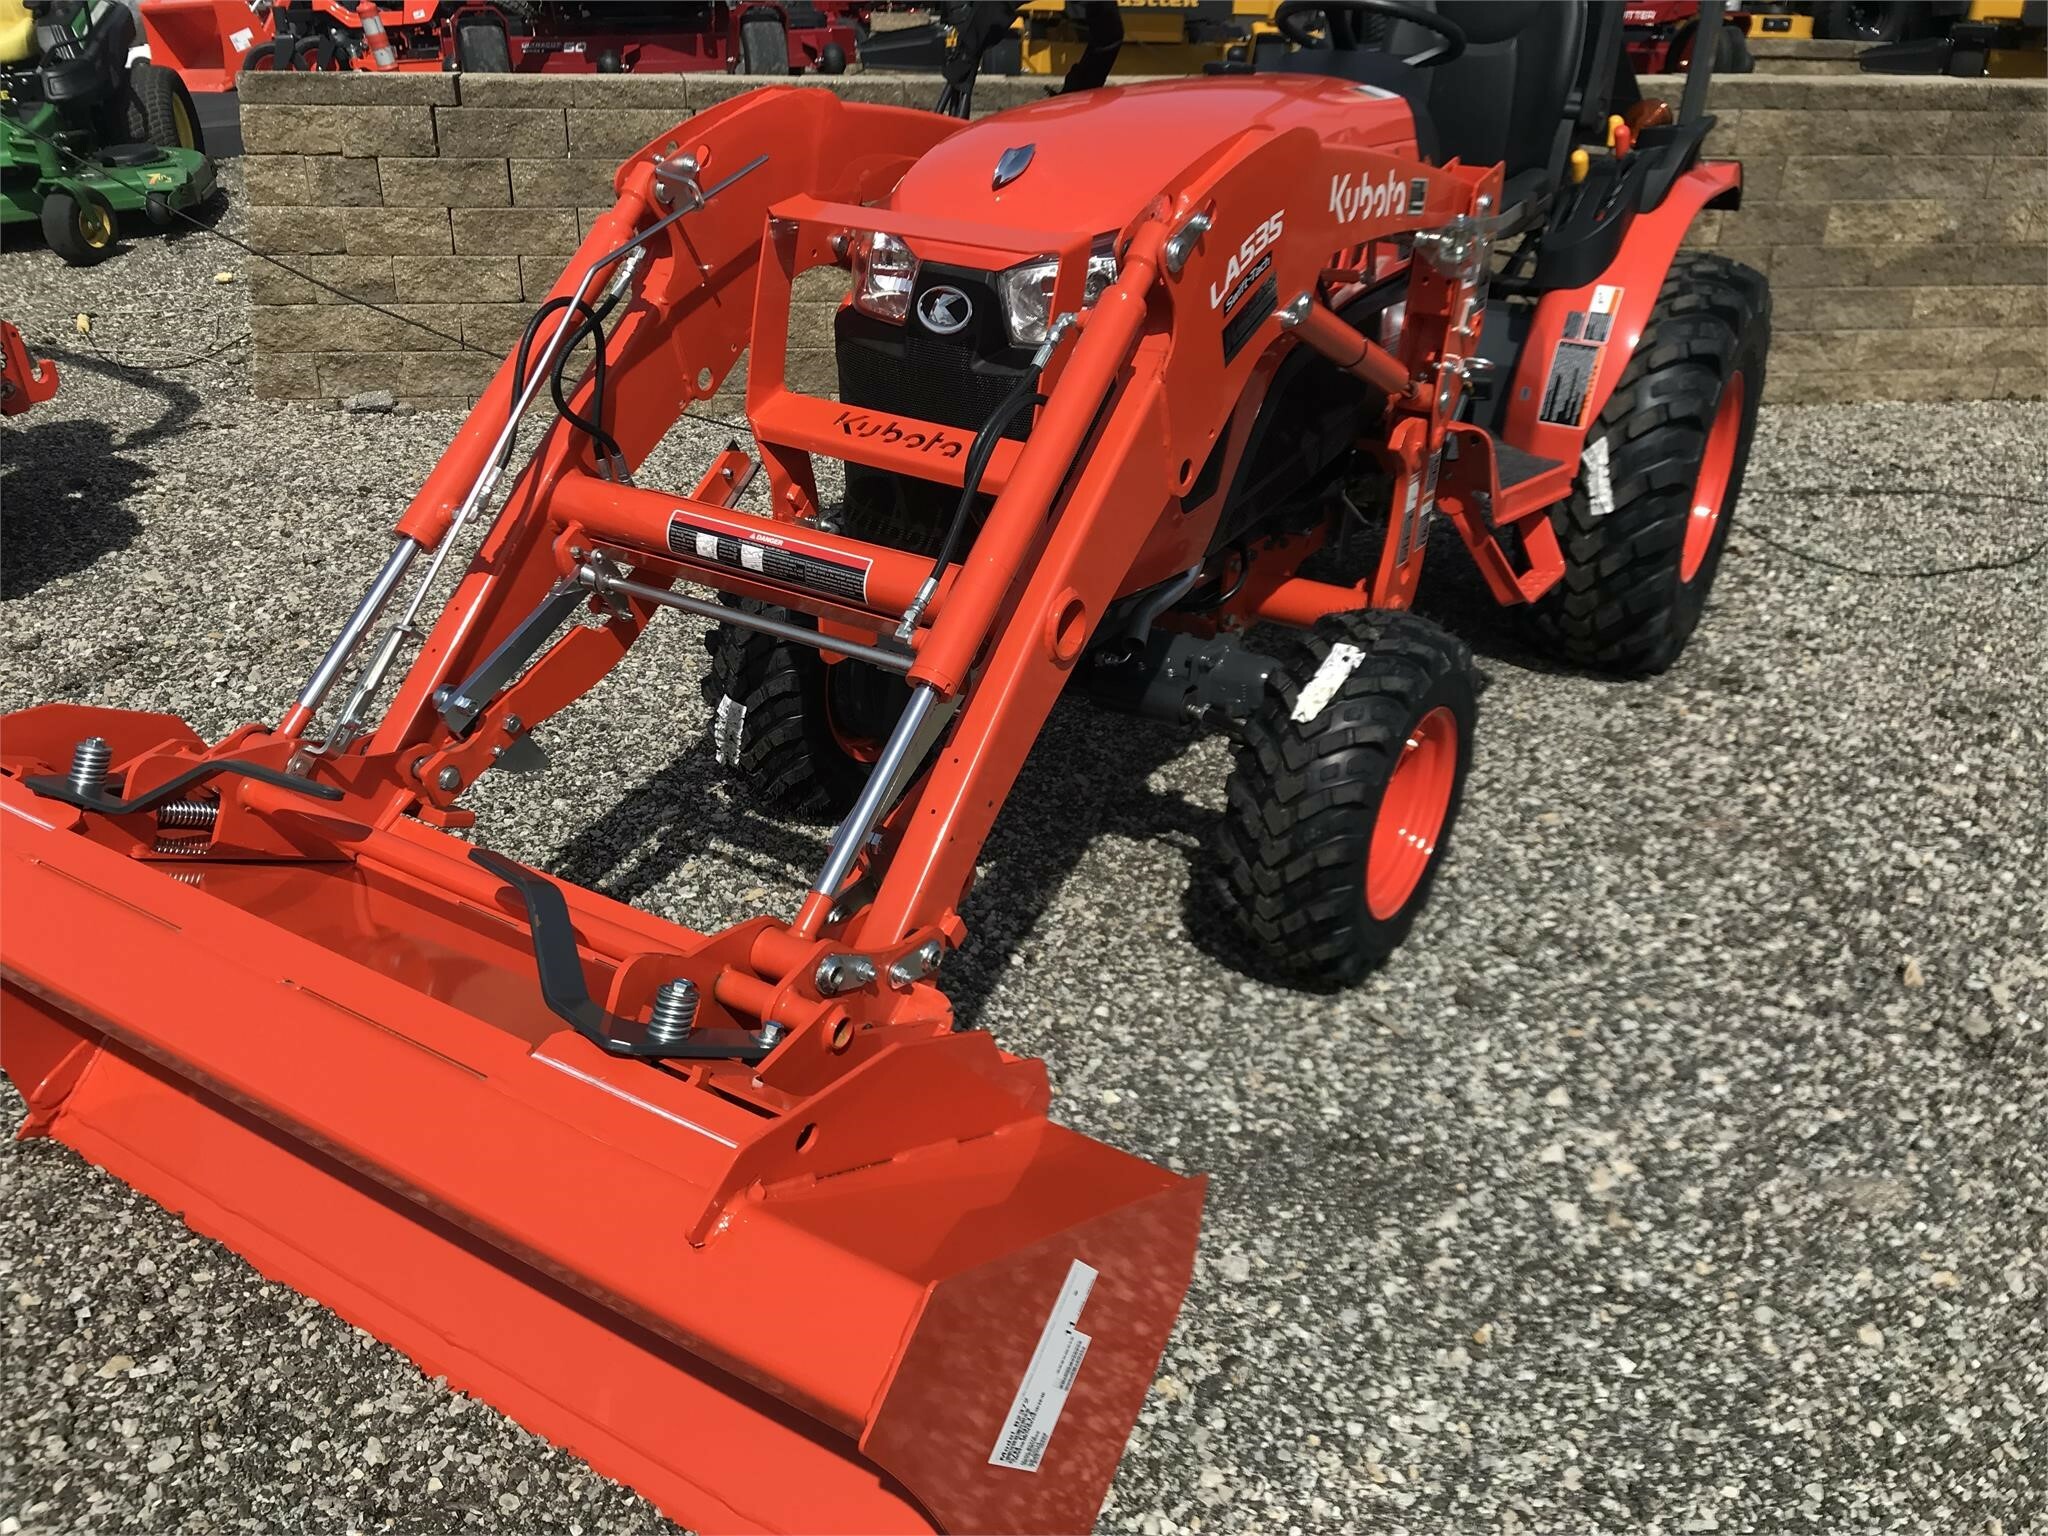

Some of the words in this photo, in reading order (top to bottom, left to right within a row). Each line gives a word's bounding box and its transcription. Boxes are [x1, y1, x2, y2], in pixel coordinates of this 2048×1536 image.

[1329, 168, 1406, 224] Kubota
[1210, 209, 1285, 309] LA535
[833, 411, 963, 459] Kubota
[755, 533, 784, 547] DANGER
